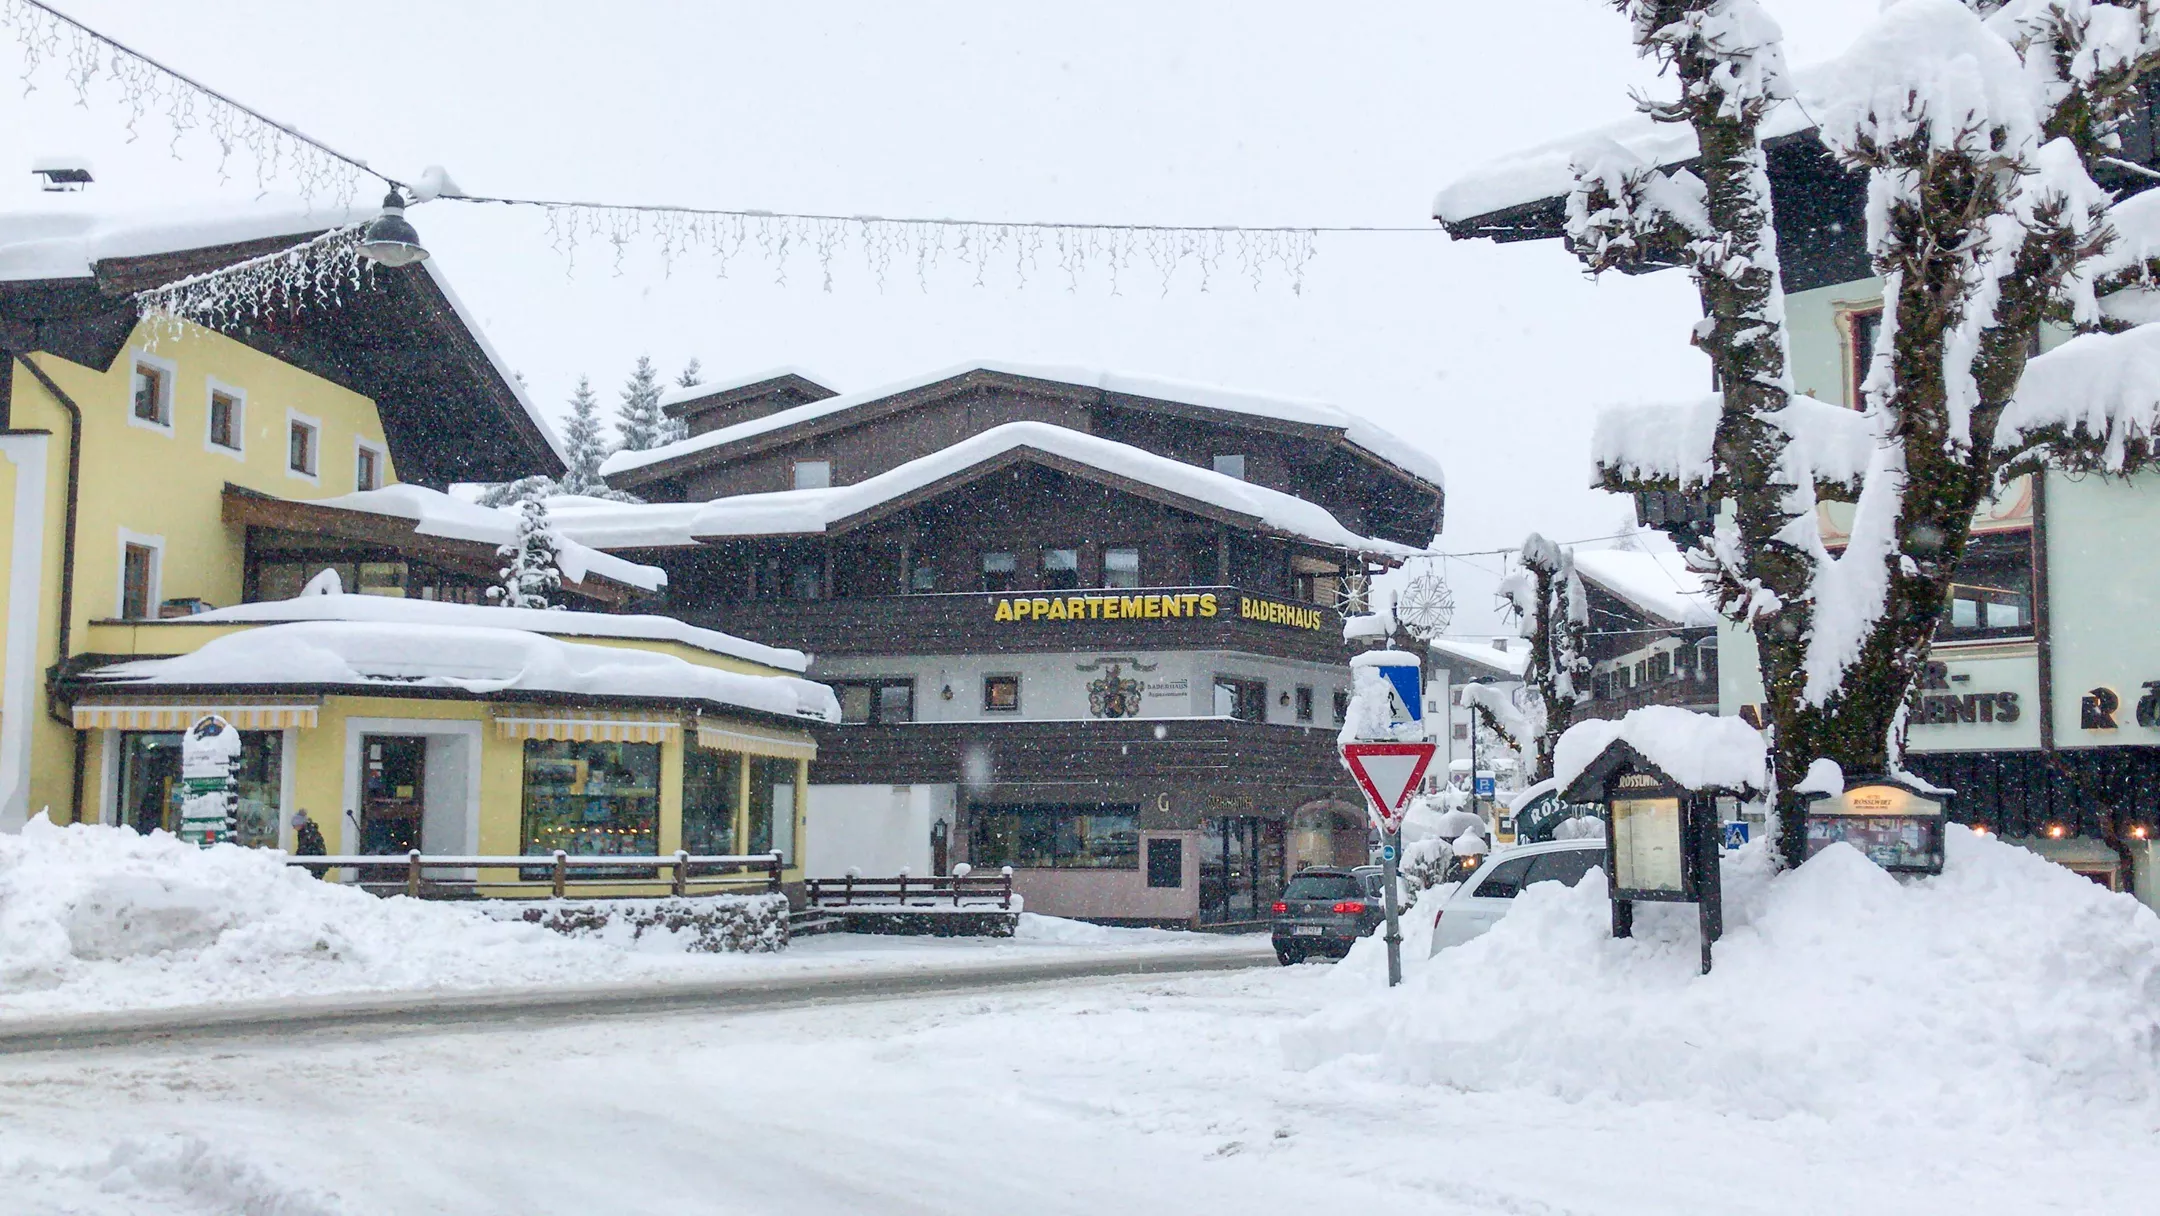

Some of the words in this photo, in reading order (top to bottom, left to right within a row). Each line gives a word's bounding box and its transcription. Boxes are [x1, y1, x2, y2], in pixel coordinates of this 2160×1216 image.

[994, 593, 1218, 621] APPARTEMENTS
[1241, 596, 1321, 631] BADERHAUS
[1157, 792, 1169, 812] G
